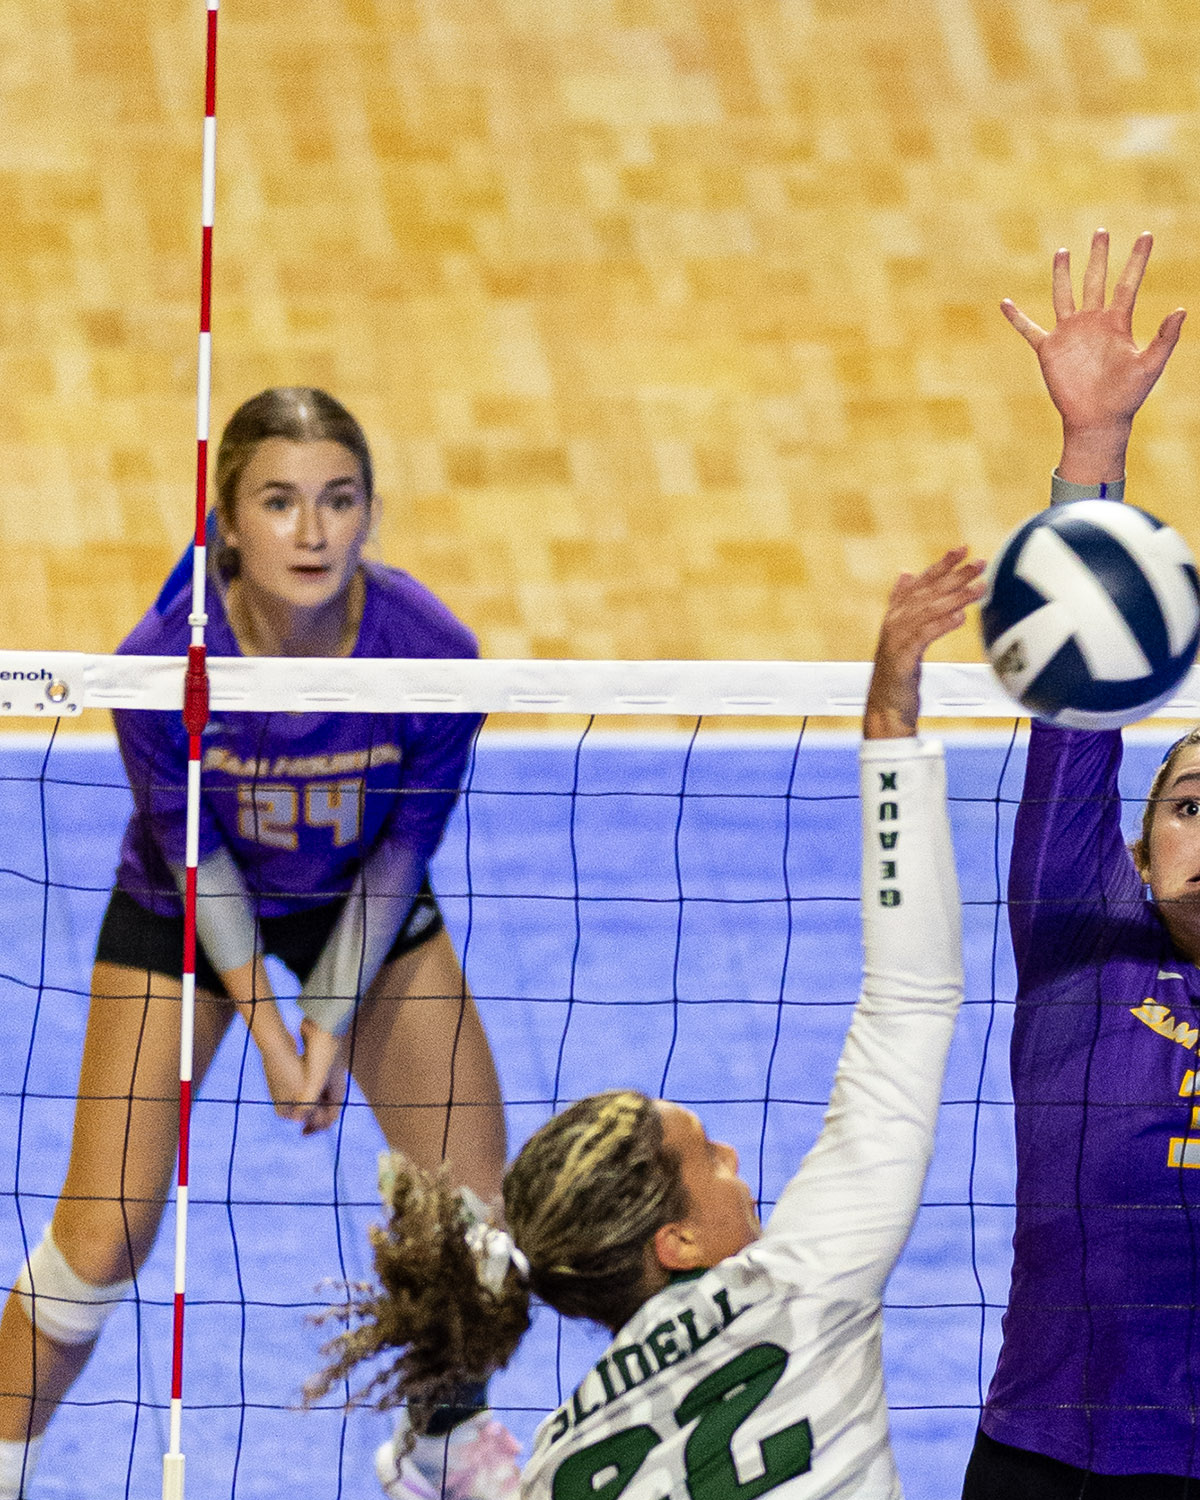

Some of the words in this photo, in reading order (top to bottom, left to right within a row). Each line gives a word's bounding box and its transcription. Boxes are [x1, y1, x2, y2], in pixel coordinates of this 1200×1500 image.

[0, 668, 53, 681] enoh
[236, 777, 366, 852] 24
[878, 772, 902, 908] GEAUX
